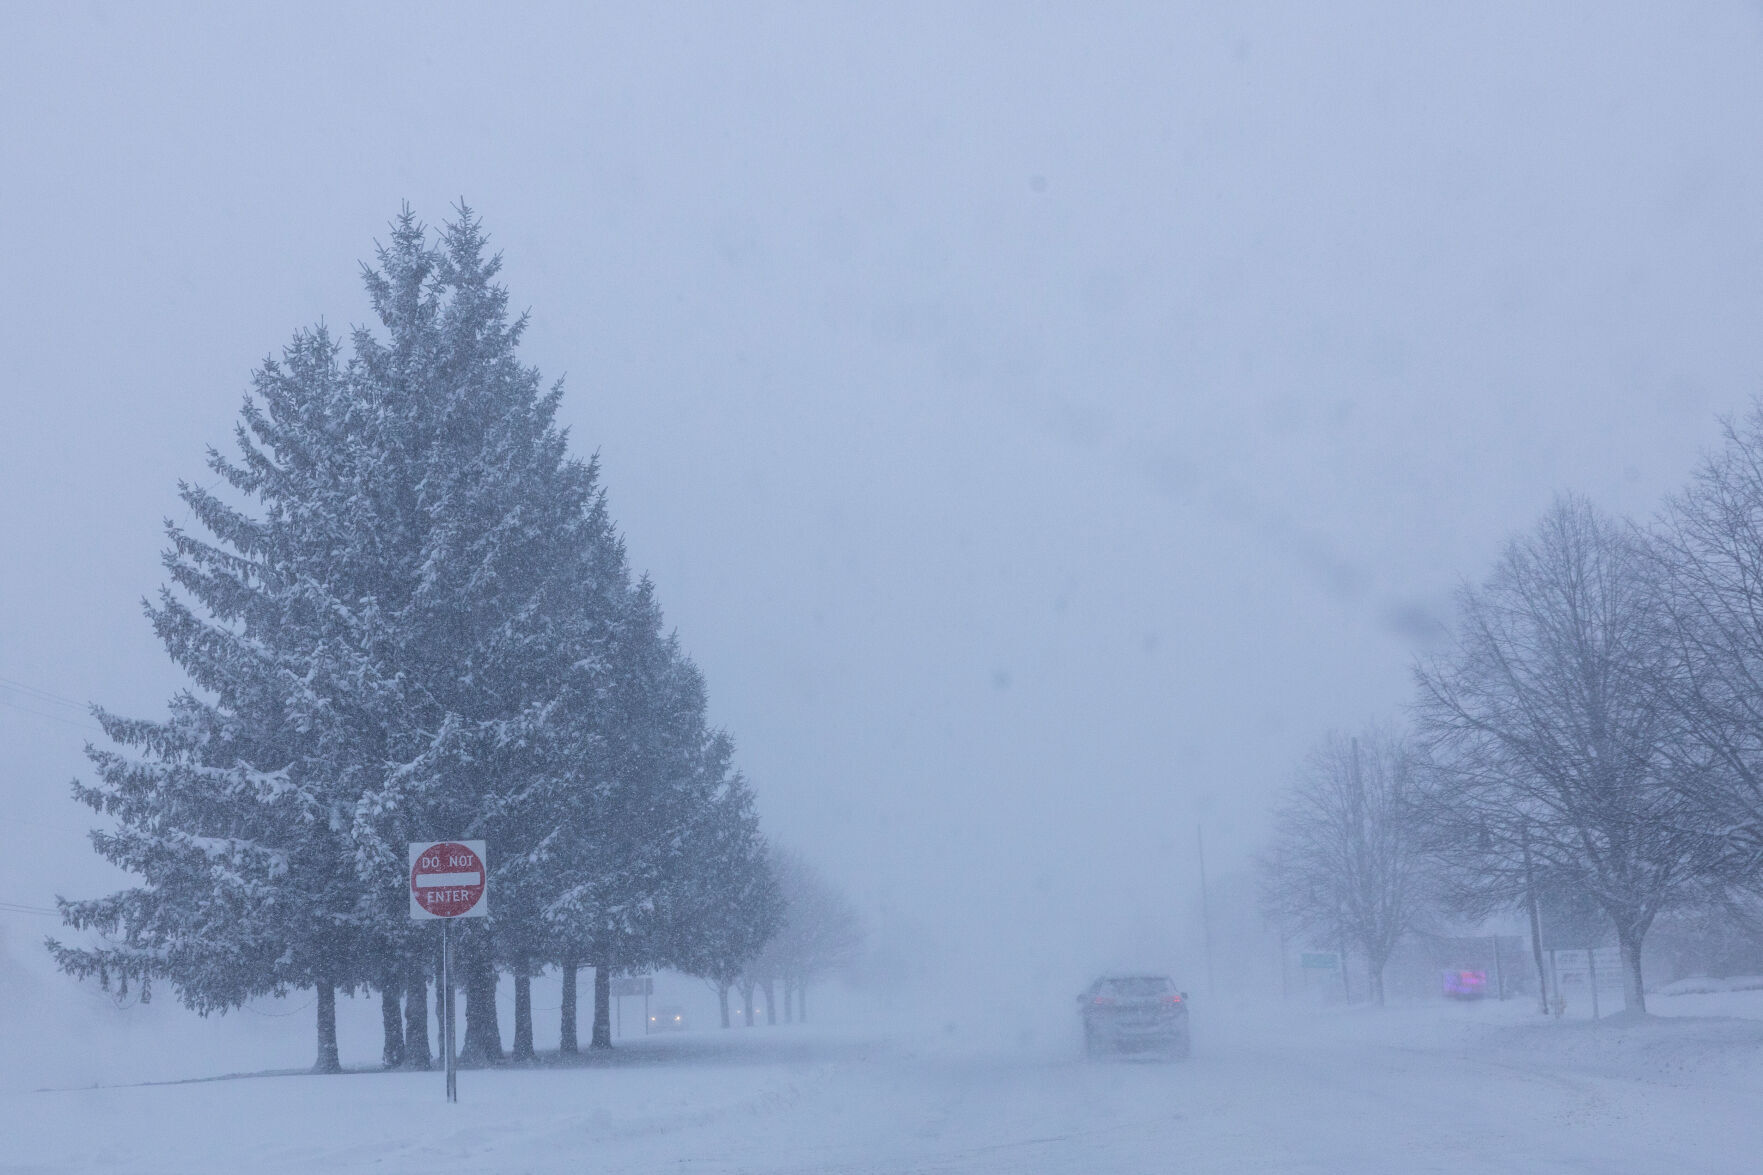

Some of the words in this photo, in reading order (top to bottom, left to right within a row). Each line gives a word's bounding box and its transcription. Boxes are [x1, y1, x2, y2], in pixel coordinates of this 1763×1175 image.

[422, 856, 440, 868] DO
[449, 855, 474, 867] NOT
[427, 890, 469, 903] ENTER
